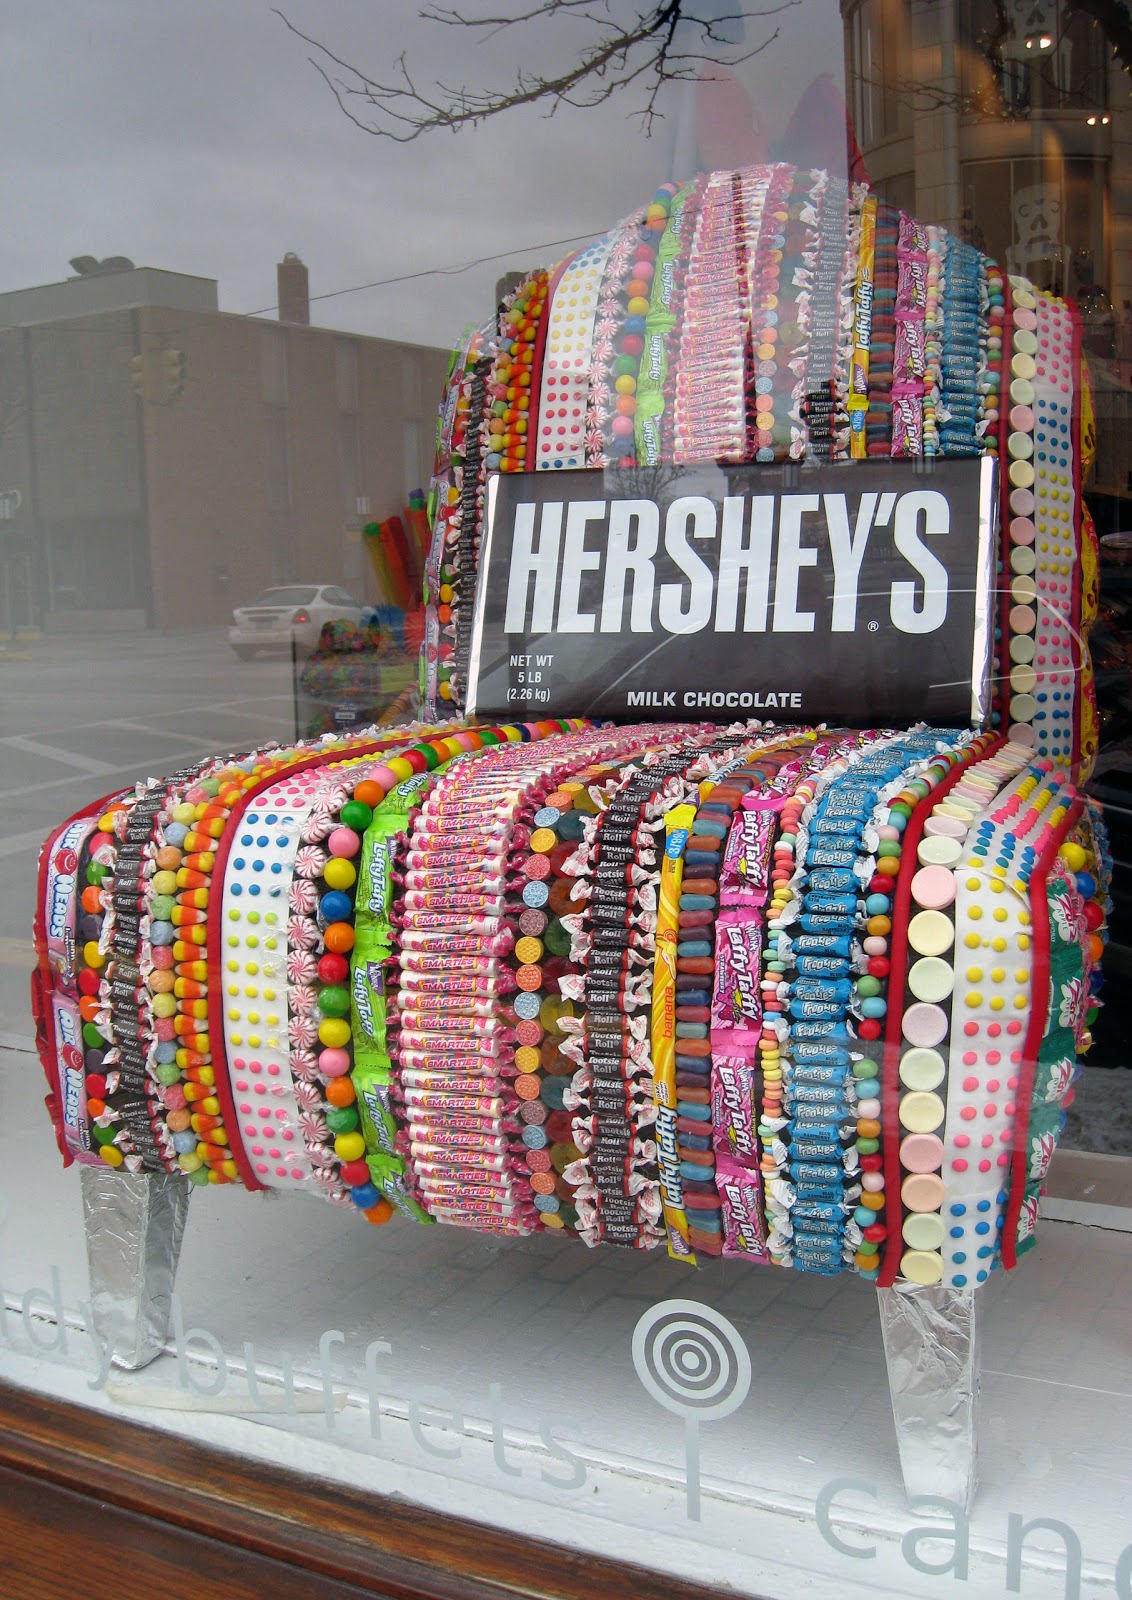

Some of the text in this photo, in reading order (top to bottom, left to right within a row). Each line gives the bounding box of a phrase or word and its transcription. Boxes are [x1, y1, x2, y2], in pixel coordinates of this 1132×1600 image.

[503, 489, 950, 635] HERSHEY'S
[509, 654, 554, 667] NET WT
[517, 671, 542, 683] 5 LB
[506, 688, 551, 703] (2.26 kg)
[626, 691, 802, 709] MILK CHOCOLATE
[634, 772, 663, 783] Tootsie
[442, 801, 494, 813] SMARTIES
[608, 803, 639, 813] Tootsie
[440, 816, 492, 828] SMARTIES
[816, 818, 857, 832] Frooties
[603, 833, 622, 841] Roll
[607, 852, 626, 860] Roll
[813, 849, 853, 864] Frooties
[117, 862, 133, 870] Roll
[428, 872, 481, 886] SMARTIES
[596, 870, 624, 878] ootsie
[49, 822, 88, 939] AIR HEADS
[809, 873, 850, 890] Frooties
[594, 886, 627, 897] Tootsie
[429, 893, 480, 906] SMARTIES
[597, 909, 617, 918] Roll
[427, 939, 478, 951] SMARTIES
[422, 957, 474, 969] SMARTIES
[594, 956, 614, 964] Roll
[803, 957, 843, 971] Frooties
[726, 927, 758, 1021] Laffy Taffy
[422, 979, 473, 991] SMARTIES
[587, 978, 618, 987] Tootsie
[114, 987, 129, 997] Roll
[590, 994, 609, 1002] Roll
[796, 986, 836, 1001] Frooties
[420, 996, 472, 1008] SMARTIES
[662, 986, 674, 1039] banana
[419, 1016, 472, 1028] SMARTIES
[594, 1015, 613, 1023] Roll
[797, 1021, 836, 1037] Frooties
[590, 1032, 622, 1040] Tootsie
[425, 1039, 477, 1049] SMARTIES
[595, 1039, 614, 1048] Roll
[427, 1057, 479, 1068] SMARTIES
[588, 1056, 620, 1065] Tootsie
[57, 1007, 84, 1128] AIR HEADS
[593, 1065, 612, 1073] Roll
[794, 1066, 833, 1080] Frooties
[124, 1075, 139, 1085] Roll
[430, 1080, 481, 1089] SMARTIES
[795, 1086, 835, 1101] Frooties
[426, 1098, 477, 1107] SMARTIES
[598, 1100, 617, 1109] Roll
[719, 1066, 753, 1156] Laffy Taffy
[796, 1103, 836, 1119] Frooties
[429, 1118, 478, 1127] SMARTIES
[431, 1134, 481, 1143] SMARTIES
[601, 1137, 620, 1145] Roll
[797, 1143, 837, 1157] Frooties
[798, 1164, 838, 1179] Frooties
[597, 1175, 617, 1184] Roll
[604, 1197, 635, 1206] Tootsie
[605, 1223, 639, 1233] Tootsie
[795, 1235, 833, 1248] Frooties
[0, 1264, 588, 1490] dy buffets
[814, 1476, 1132, 1600] can
